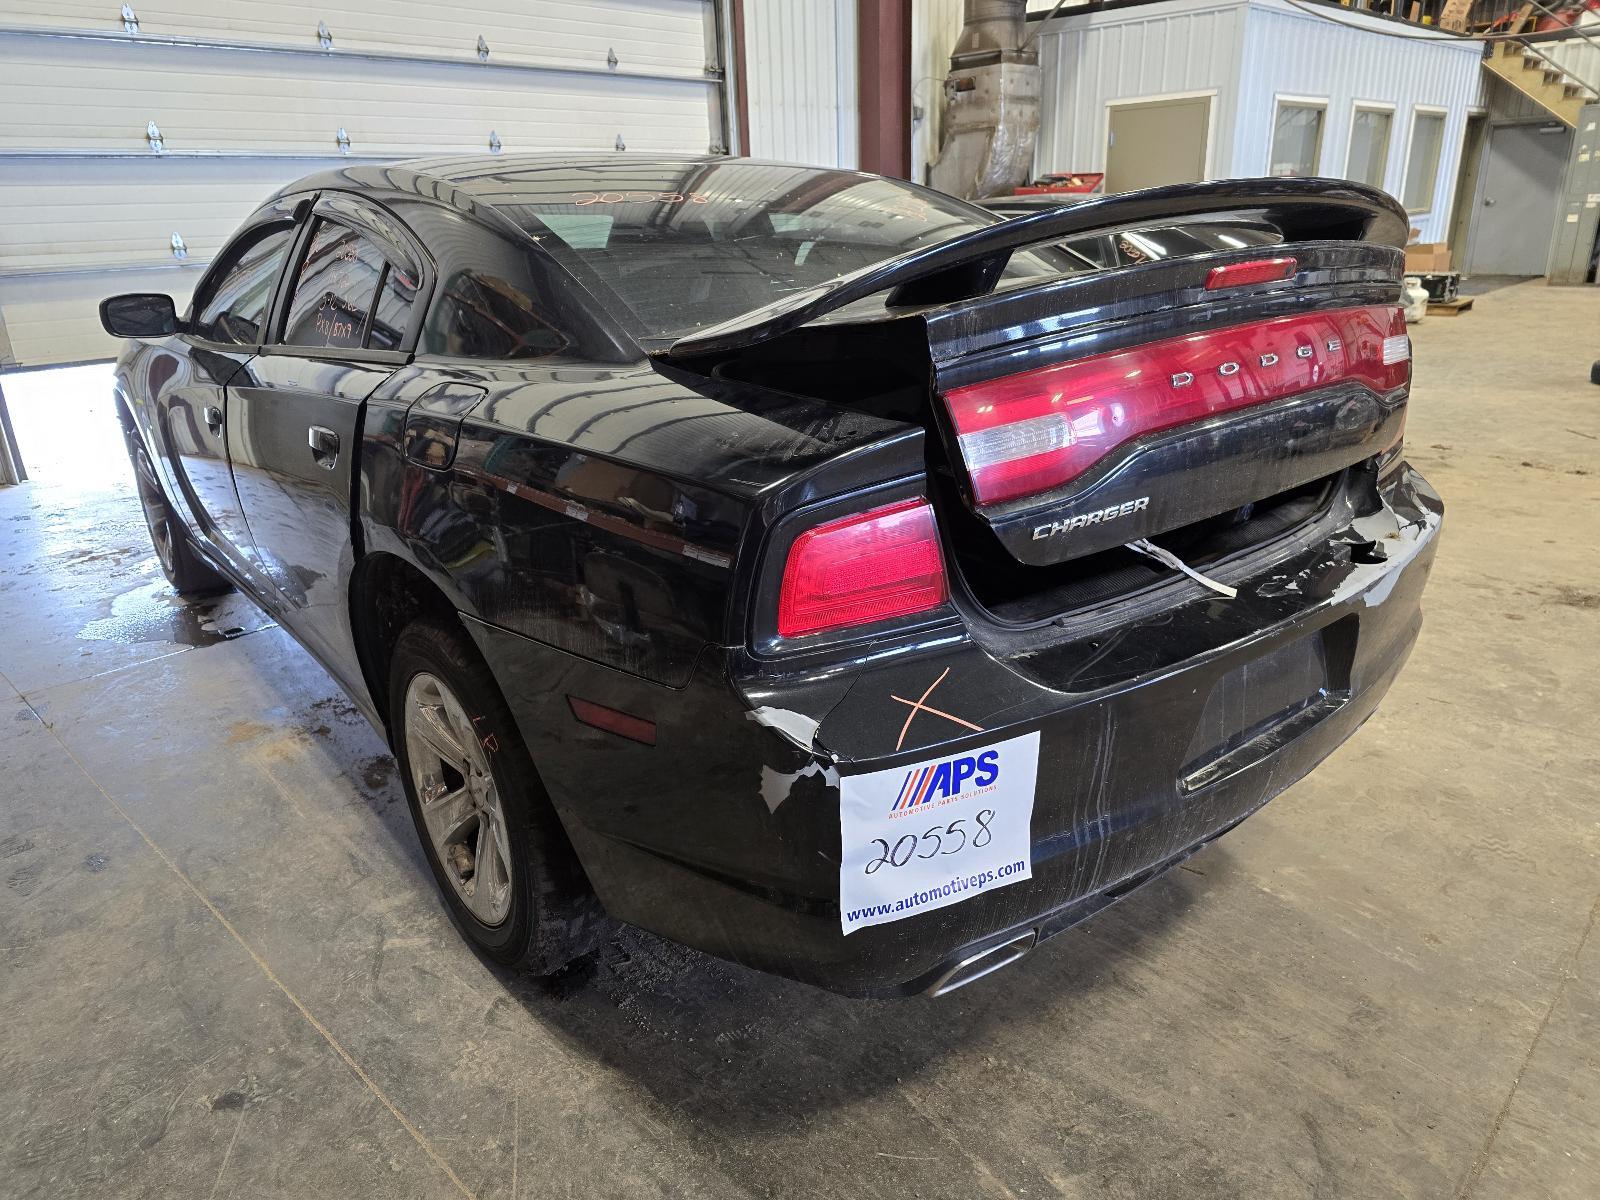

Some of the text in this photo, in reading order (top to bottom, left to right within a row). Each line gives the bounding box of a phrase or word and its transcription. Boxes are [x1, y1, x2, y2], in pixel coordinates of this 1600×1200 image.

[571, 192, 708, 206] 20558
[1171, 338, 1341, 388] DODGE
[1032, 496, 1150, 541] CHARGER
[921, 749, 999, 804] APS
[888, 785, 998, 820] AUTOMOTIVE PARTS SOLUTIONS
[864, 809, 996, 875] 20558
[846, 859, 1026, 922] www.automotiveps.com
